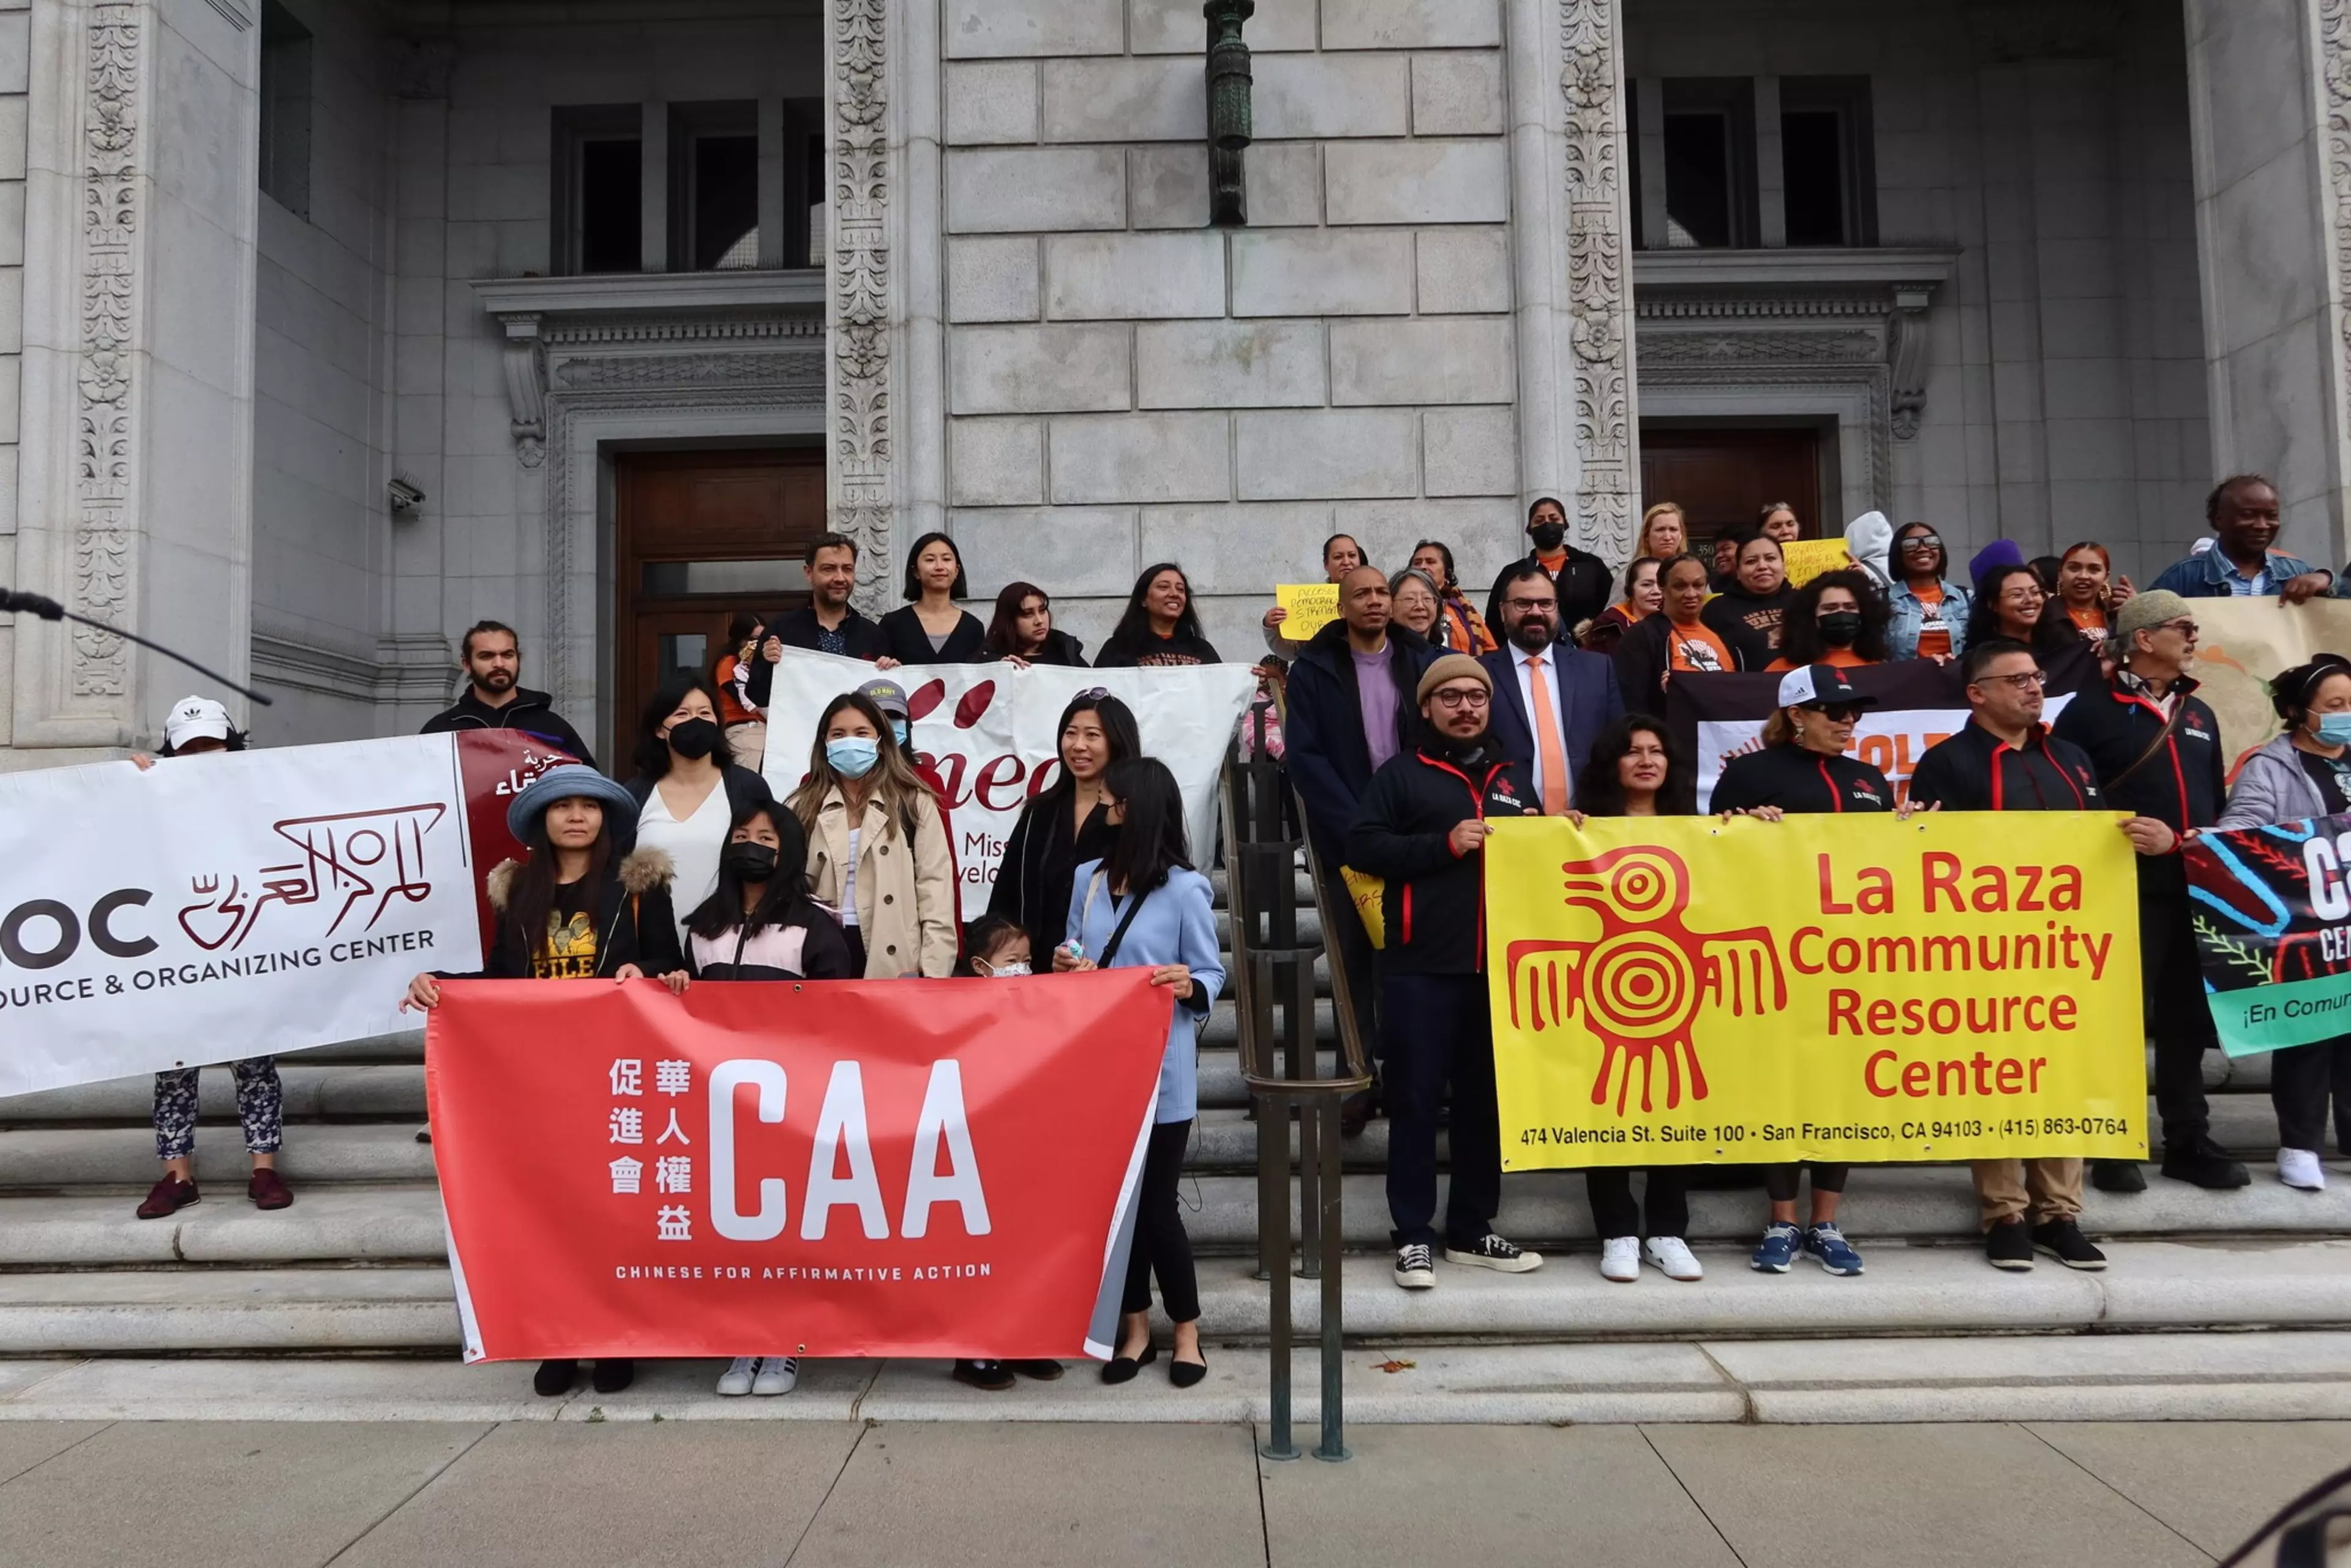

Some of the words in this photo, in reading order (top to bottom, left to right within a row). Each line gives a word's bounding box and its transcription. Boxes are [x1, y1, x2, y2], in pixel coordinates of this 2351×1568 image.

[1698, 544, 1714, 555] 350
[1491, 792, 1499, 801] LA
[1818, 852, 1894, 915] La
[1922, 852, 2082, 913] Raza
[0, 888, 159, 969] OC
[1790, 920, 2113, 980] Community
[105, 975, 124, 994] &
[133, 948, 321, 990] ORGANIZING
[330, 929, 434, 962] CENTER
[1828, 988, 2077, 1036] Resource
[2243, 1003, 2276, 1029] ¡En
[1864, 1049, 2046, 1098] Center
[609, 1059, 644, 1195] 促進會
[656, 1059, 692, 1241] 華人權益
[708, 1058, 991, 1241] CAA
[1521, 1128, 1547, 1145] 474
[1552, 1127, 1625, 1144] Valencia
[1632, 1125, 1654, 1142] St.
[1661, 1125, 1706, 1142] Suite
[1714, 1125, 1744, 1142] 100
[1763, 1124, 1794, 1141] San
[1802, 1123, 1894, 1144] Francisco,
[1902, 1122, 1927, 1139] CA
[1931, 1120, 1982, 1139] 94103
[1999, 1119, 2038, 1139] (415)
[2044, 1118, 2127, 1136] 863-0764
[617, 1266, 702, 1278] CHINESE
[714, 1267, 751, 1278] FOR
[763, 1268, 901, 1280] AFFIRMATIVE
[913, 1264, 991, 1279] ACTION
